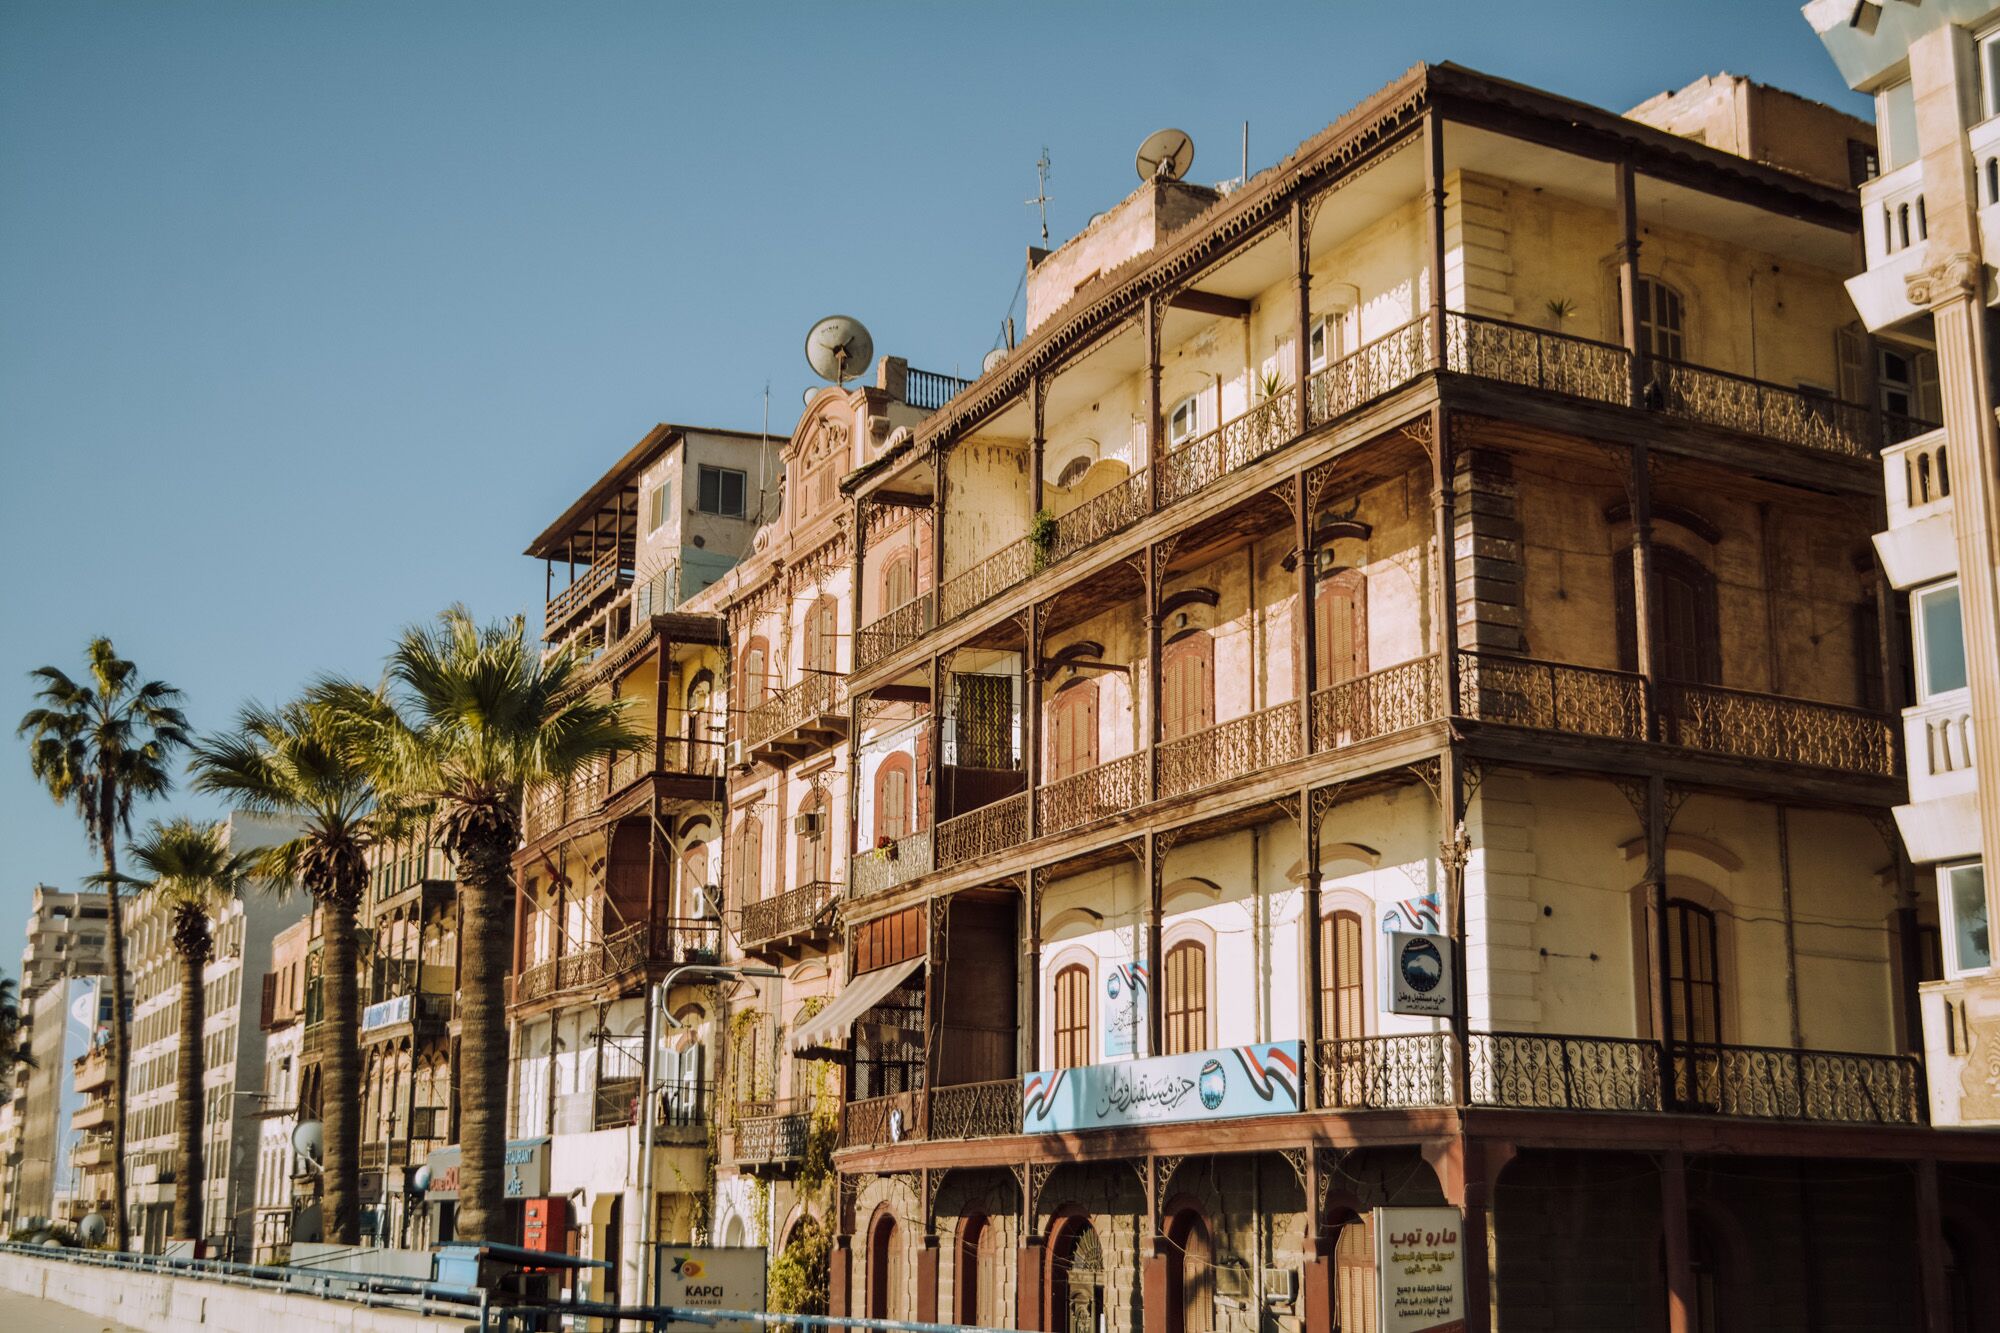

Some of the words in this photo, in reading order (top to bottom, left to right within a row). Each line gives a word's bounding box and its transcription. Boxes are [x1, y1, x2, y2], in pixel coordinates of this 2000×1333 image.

[1160, 1075, 1195, 1109] حزب
[505, 1148, 533, 1165] STAURANT
[1389, 1228, 1423, 1248] توب
[1425, 1228, 1457, 1247] مارو
[685, 1285, 723, 1297] KAPCI
